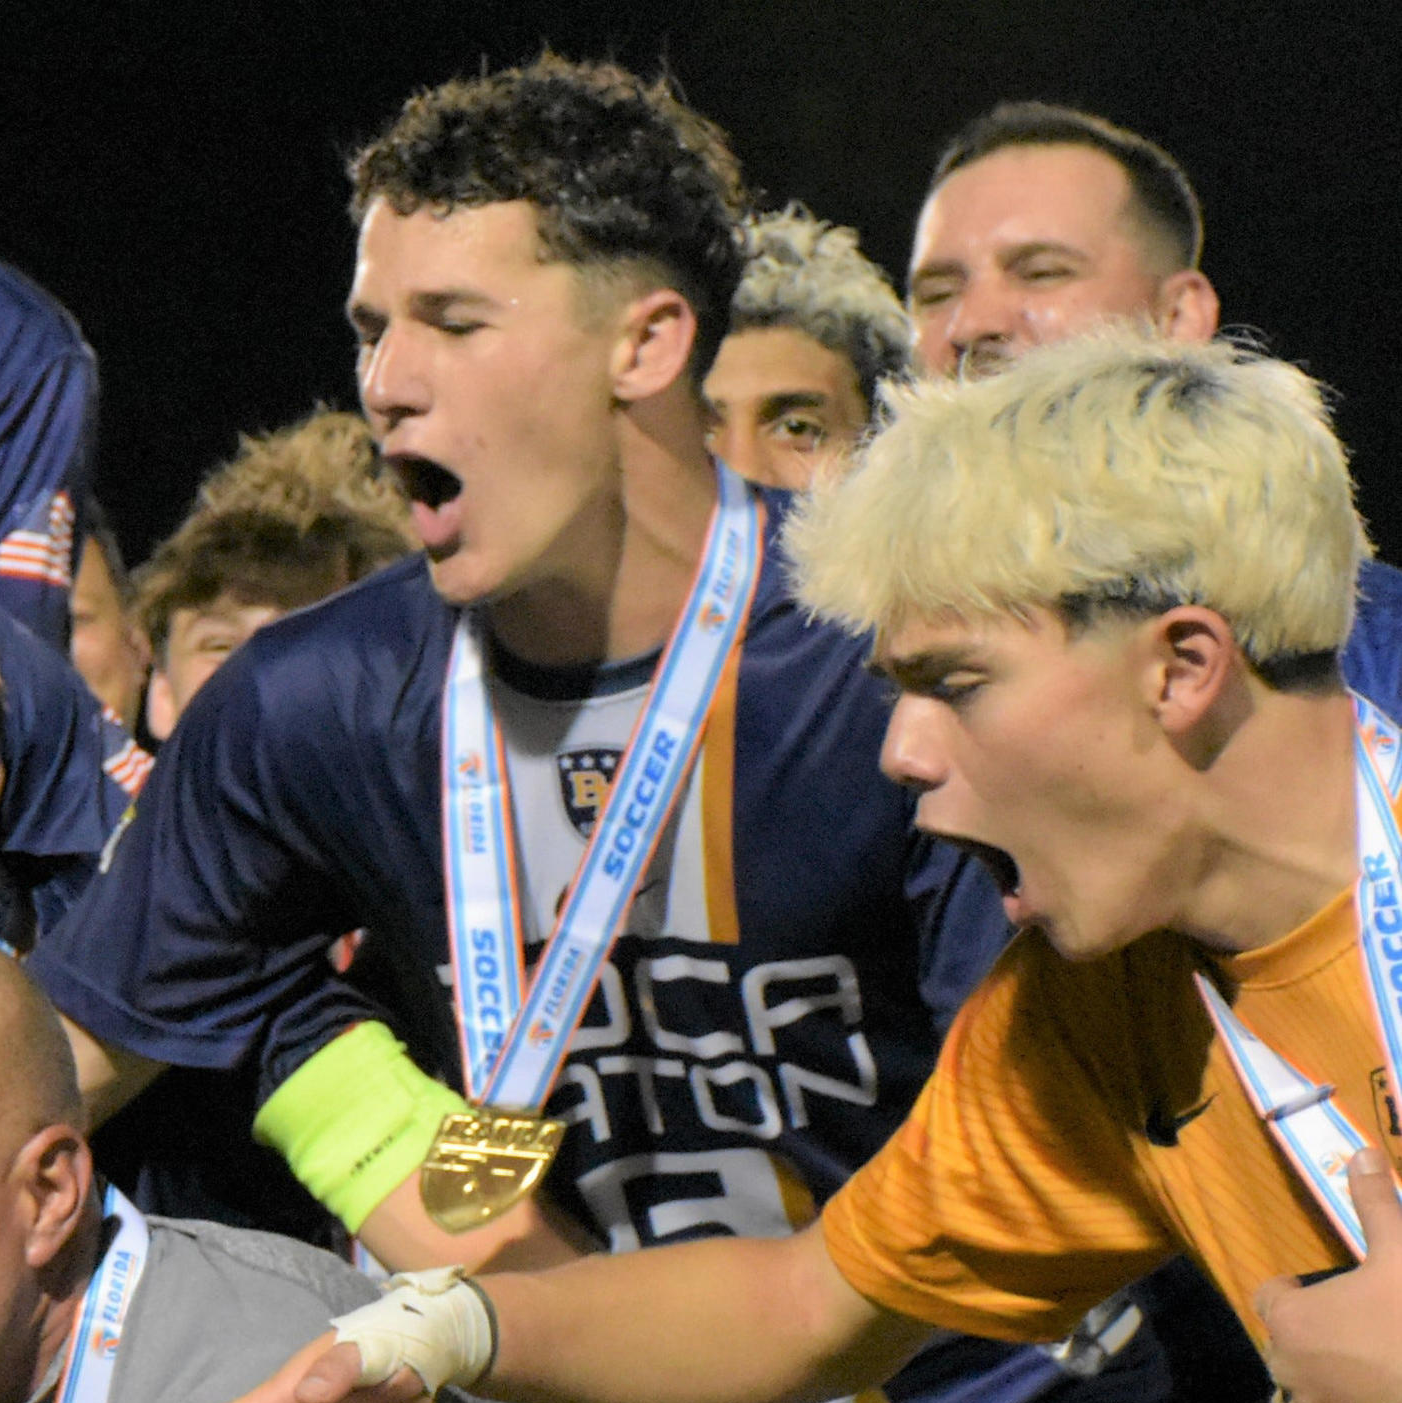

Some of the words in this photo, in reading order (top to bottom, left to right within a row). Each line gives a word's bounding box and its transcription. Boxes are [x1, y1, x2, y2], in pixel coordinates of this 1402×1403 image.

[603, 730, 677, 881] SOCCER
[545, 948, 581, 1016] FLORIDA
[1363, 851, 1402, 1018] OCCER
[551, 1031, 877, 1144] ATON
[102, 1249, 132, 1324] FLORIDA
